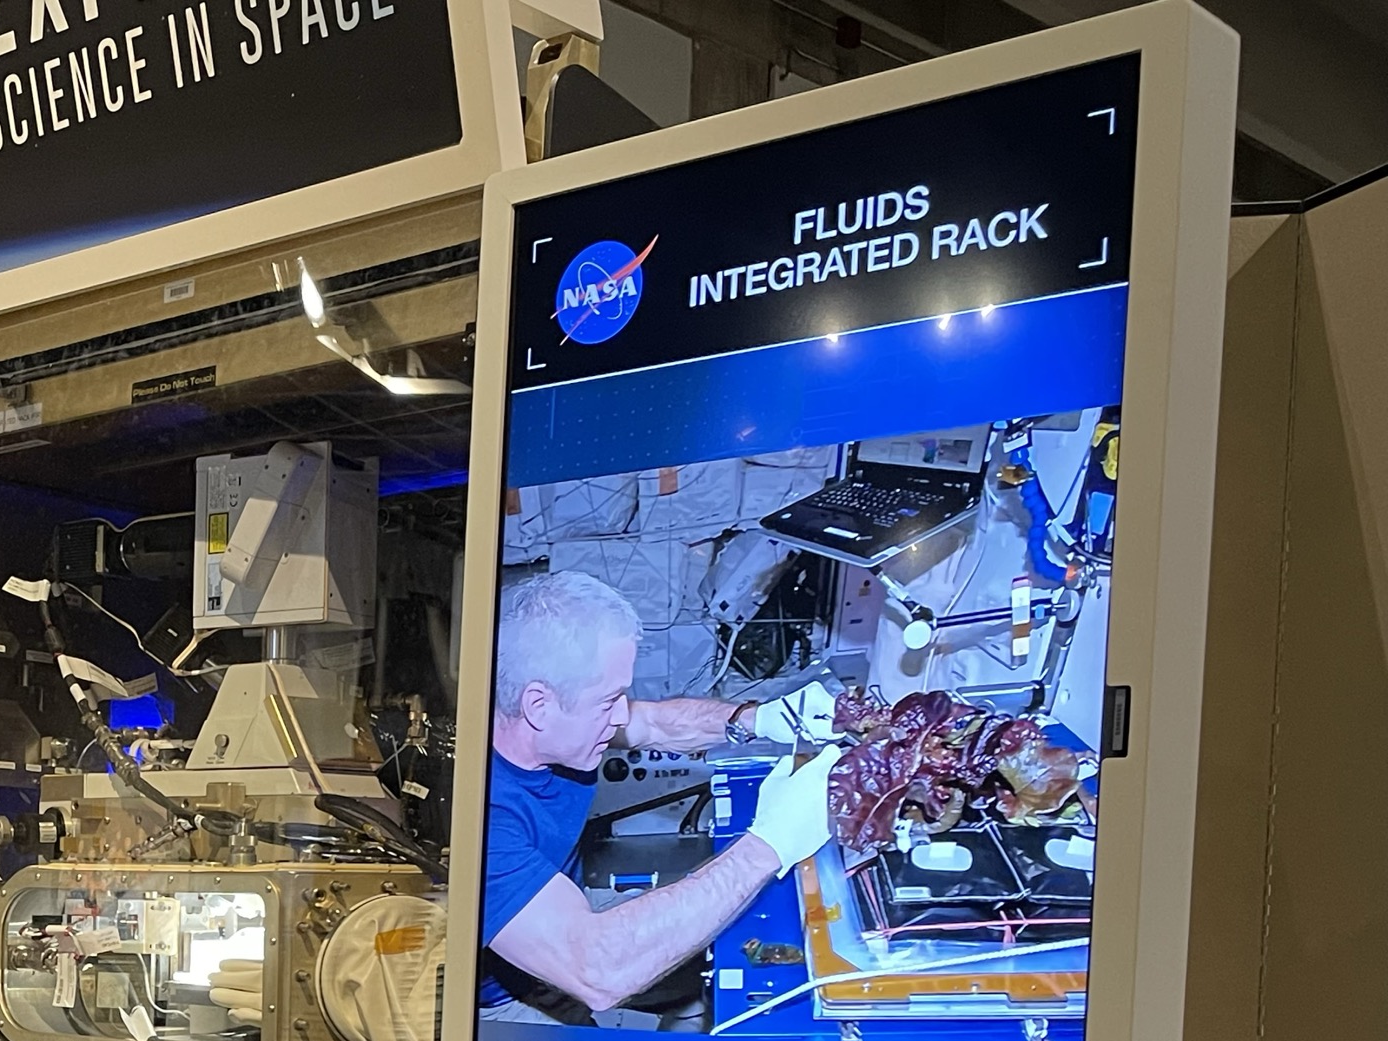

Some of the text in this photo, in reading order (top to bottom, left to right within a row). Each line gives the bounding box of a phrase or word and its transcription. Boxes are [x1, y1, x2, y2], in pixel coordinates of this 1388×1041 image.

[167, 2, 215, 88] IN
[234, 0, 395, 65] SPA
[793, 184, 930, 245] FLUIDS
[689, 203, 1050, 308] INTEGRATED RACK
[562, 274, 638, 311] NASA
[132, 373, 215, 397] Please Do Not Touch
